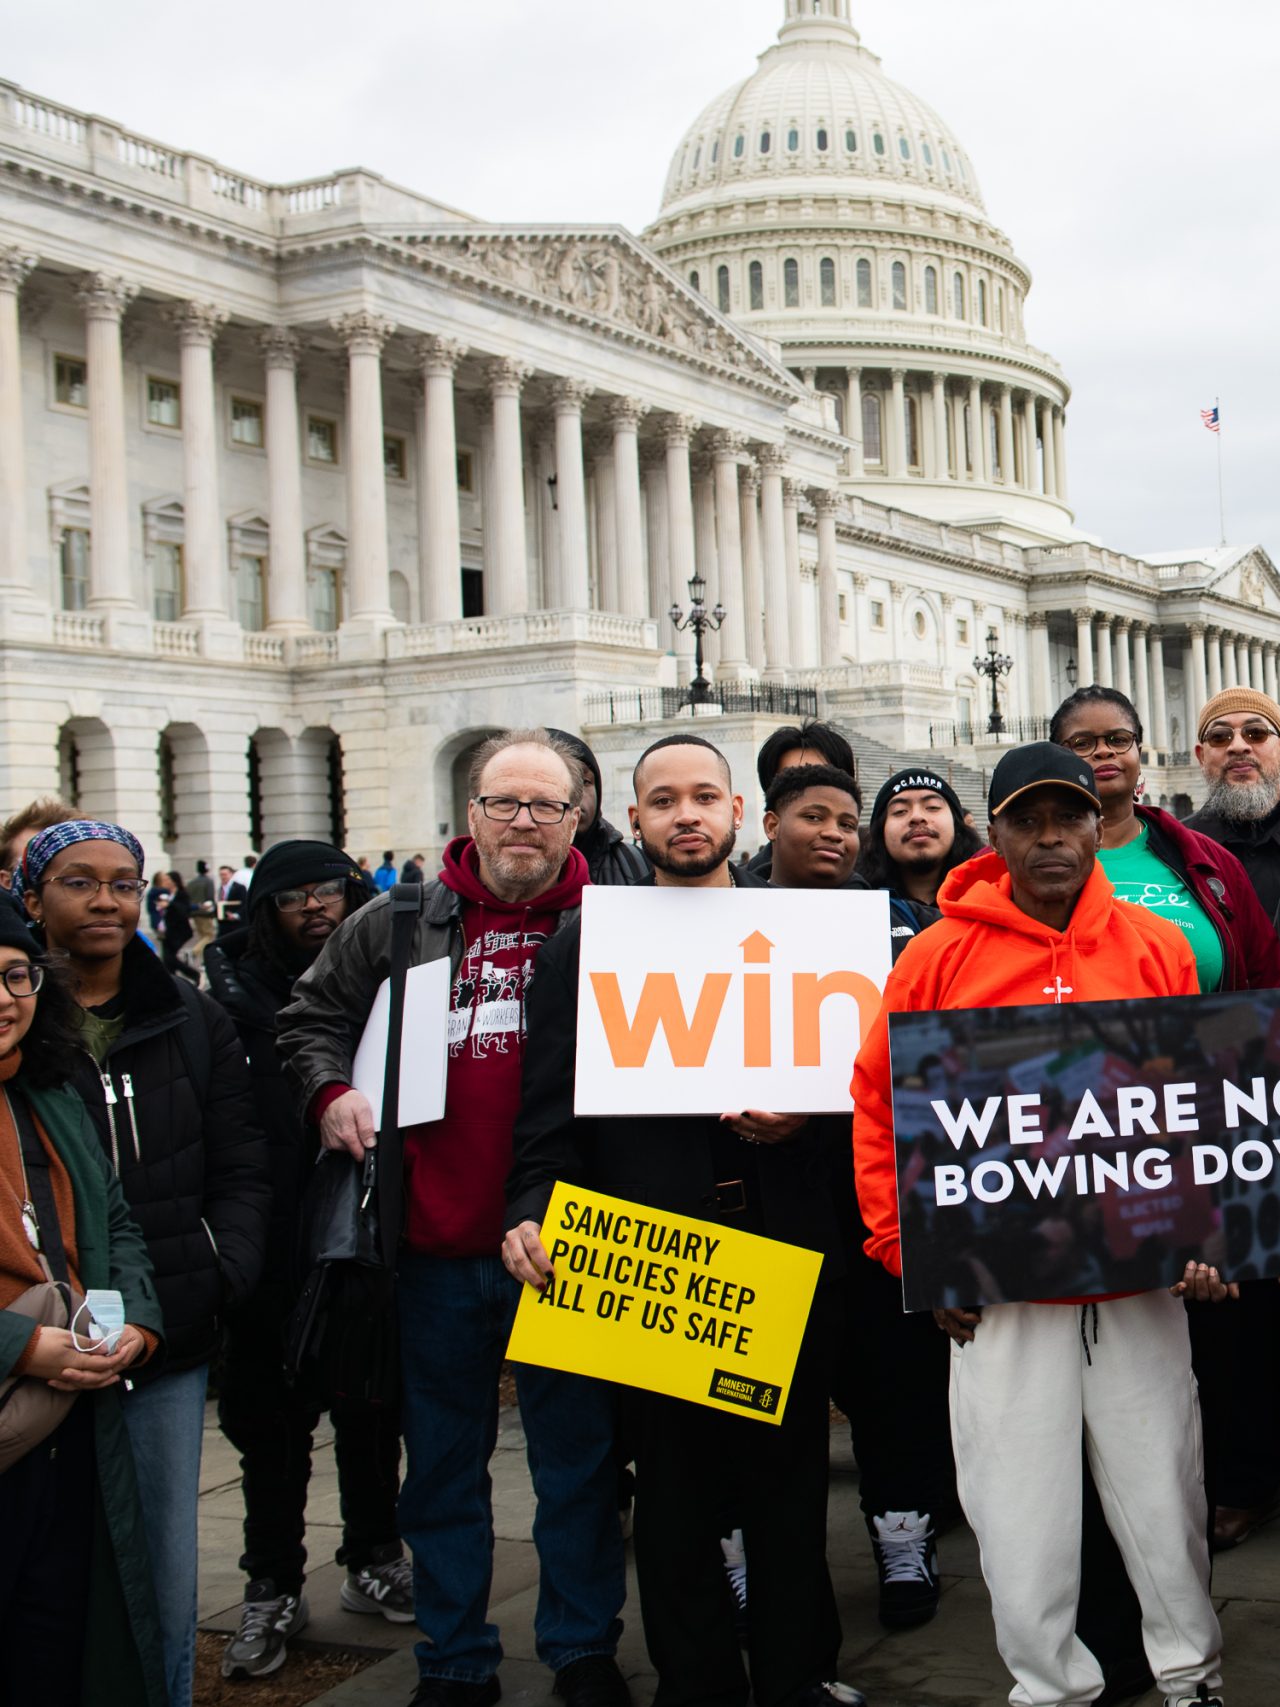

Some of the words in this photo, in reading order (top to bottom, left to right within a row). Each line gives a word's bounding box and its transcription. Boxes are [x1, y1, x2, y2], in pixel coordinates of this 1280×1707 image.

[589, 929, 883, 1068] win
[930, 1093, 1044, 1150] WE
[1067, 1082, 1200, 1140] ARE
[934, 1148, 1173, 1207] BOWING
[560, 1201, 720, 1266] SANCTUARY
[550, 1239, 679, 1296] POLICIES
[685, 1272, 755, 1315] KEEP
[538, 1278, 585, 1313] ALL
[596, 1290, 634, 1322] OF
[641, 1300, 678, 1334] US
[685, 1312, 753, 1356] SAFE
[716, 1386, 752, 1402] INTERNATIONAL
[718, 1377, 755, 1395] AMNESTY
